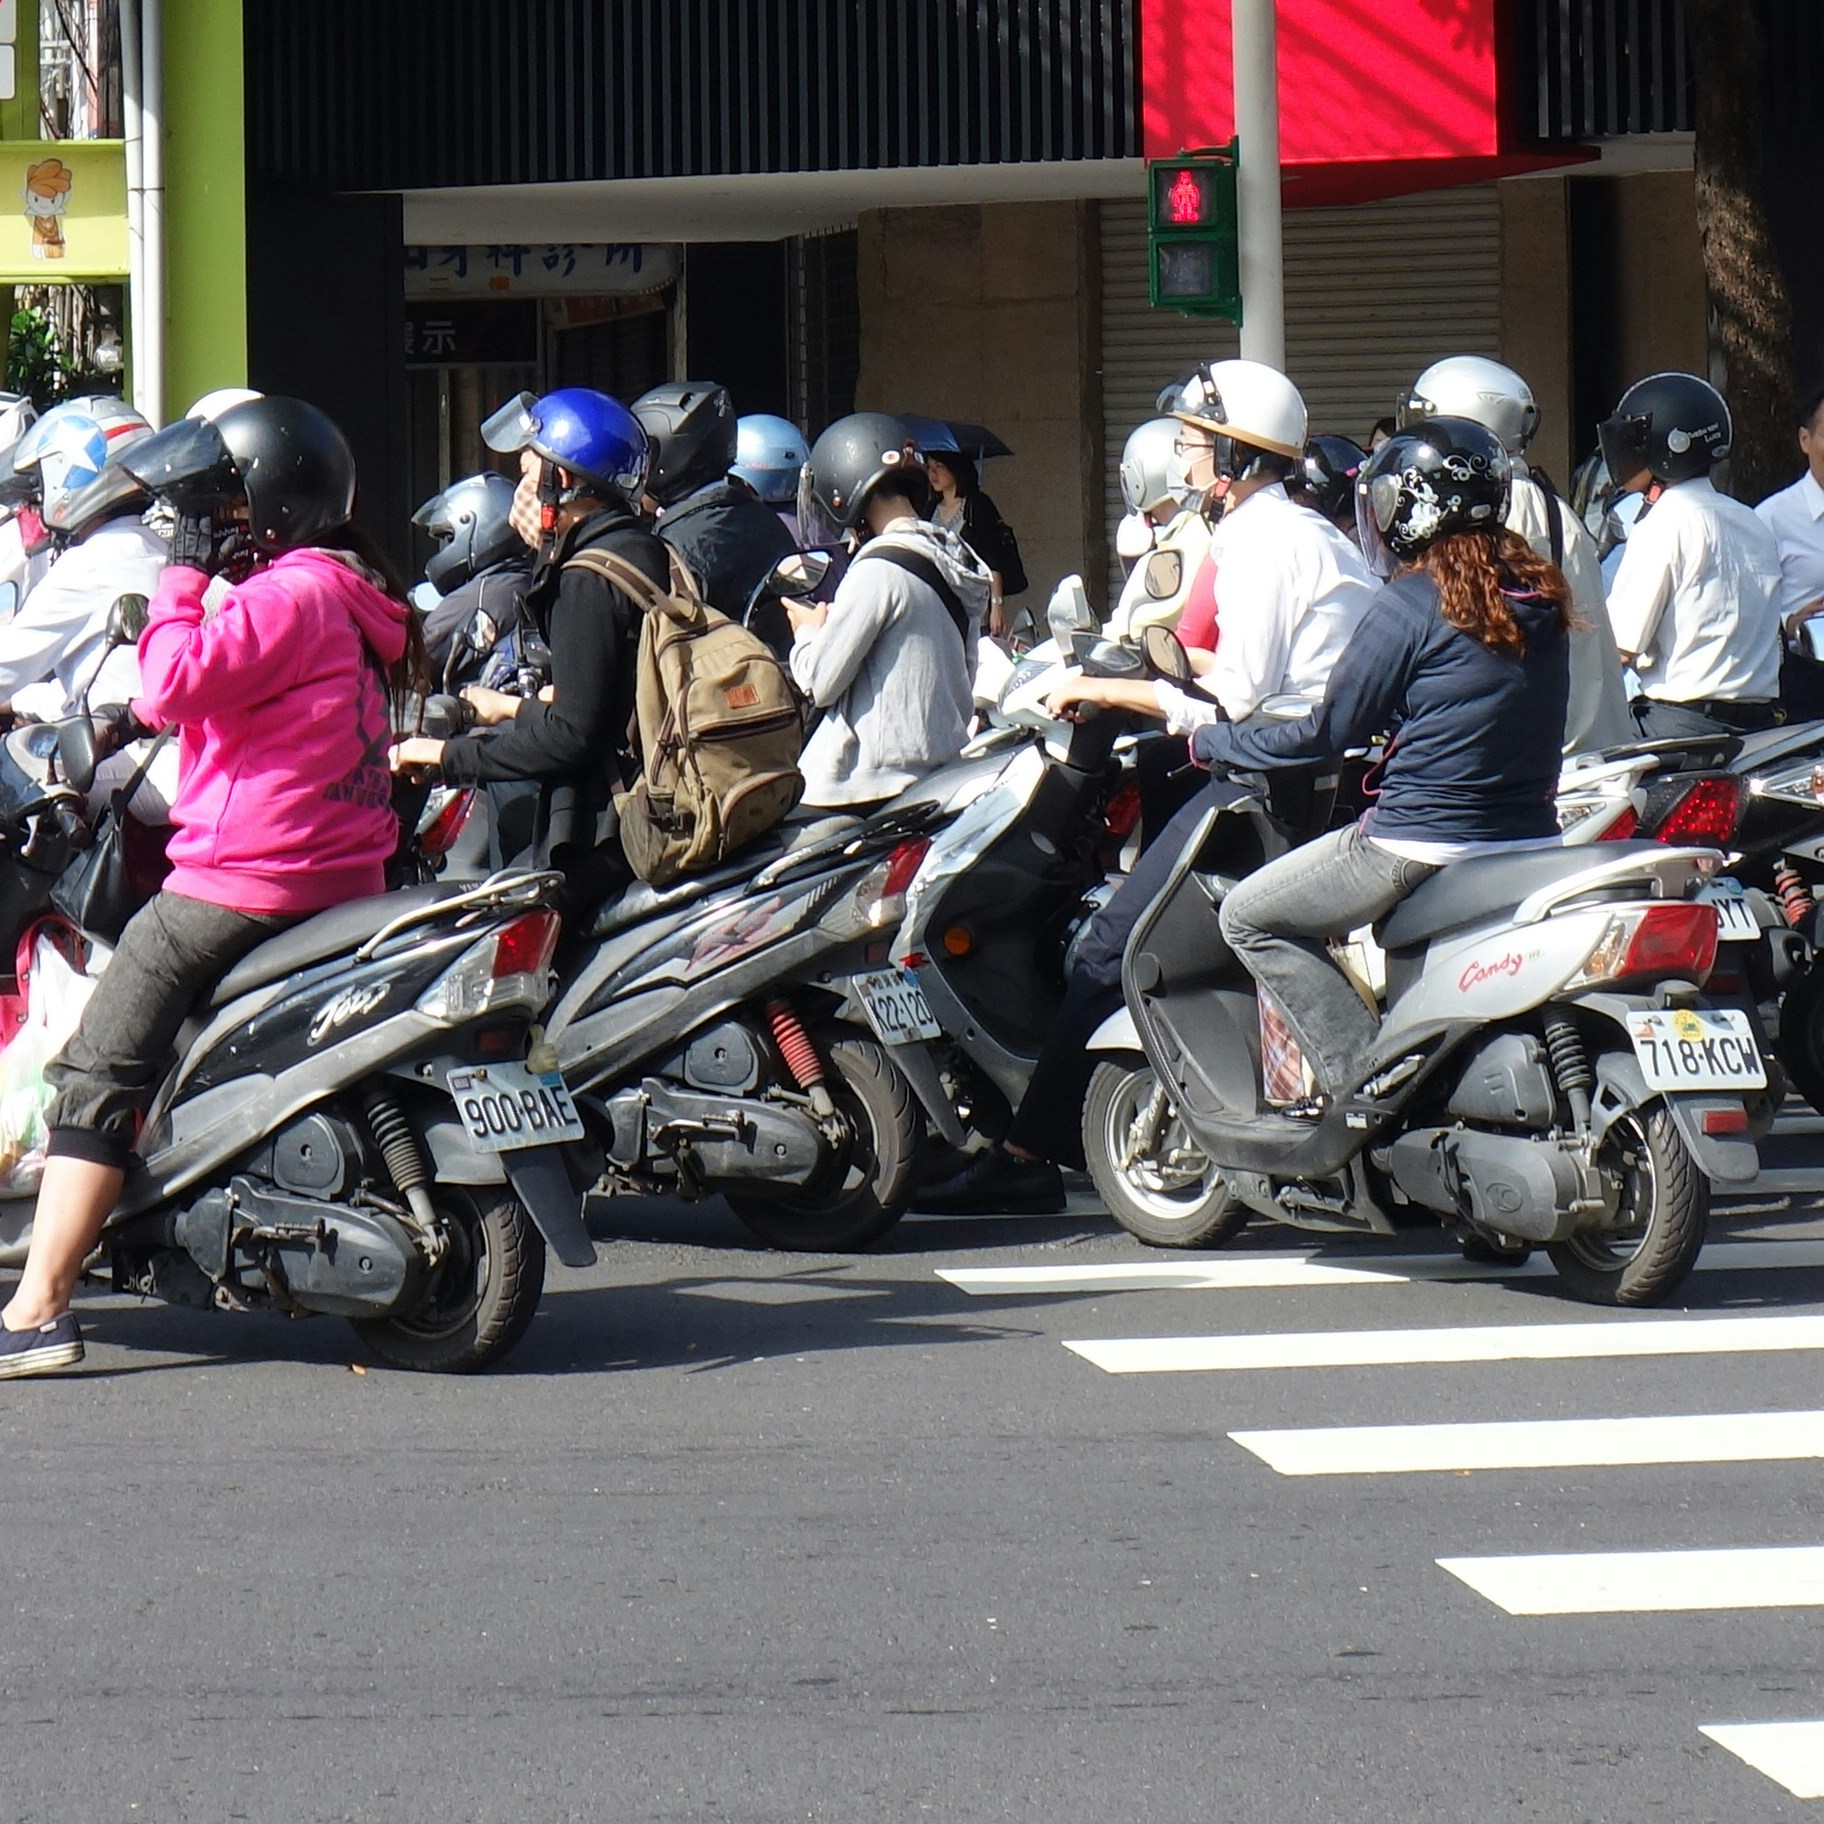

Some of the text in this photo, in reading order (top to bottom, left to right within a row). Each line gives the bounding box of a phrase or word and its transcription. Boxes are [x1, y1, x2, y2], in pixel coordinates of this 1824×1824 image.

[1458, 951, 1523, 993] Candy
[1640, 1036, 1761, 1077] 718-KCW
[463, 1085, 577, 1138] 900-BAE
